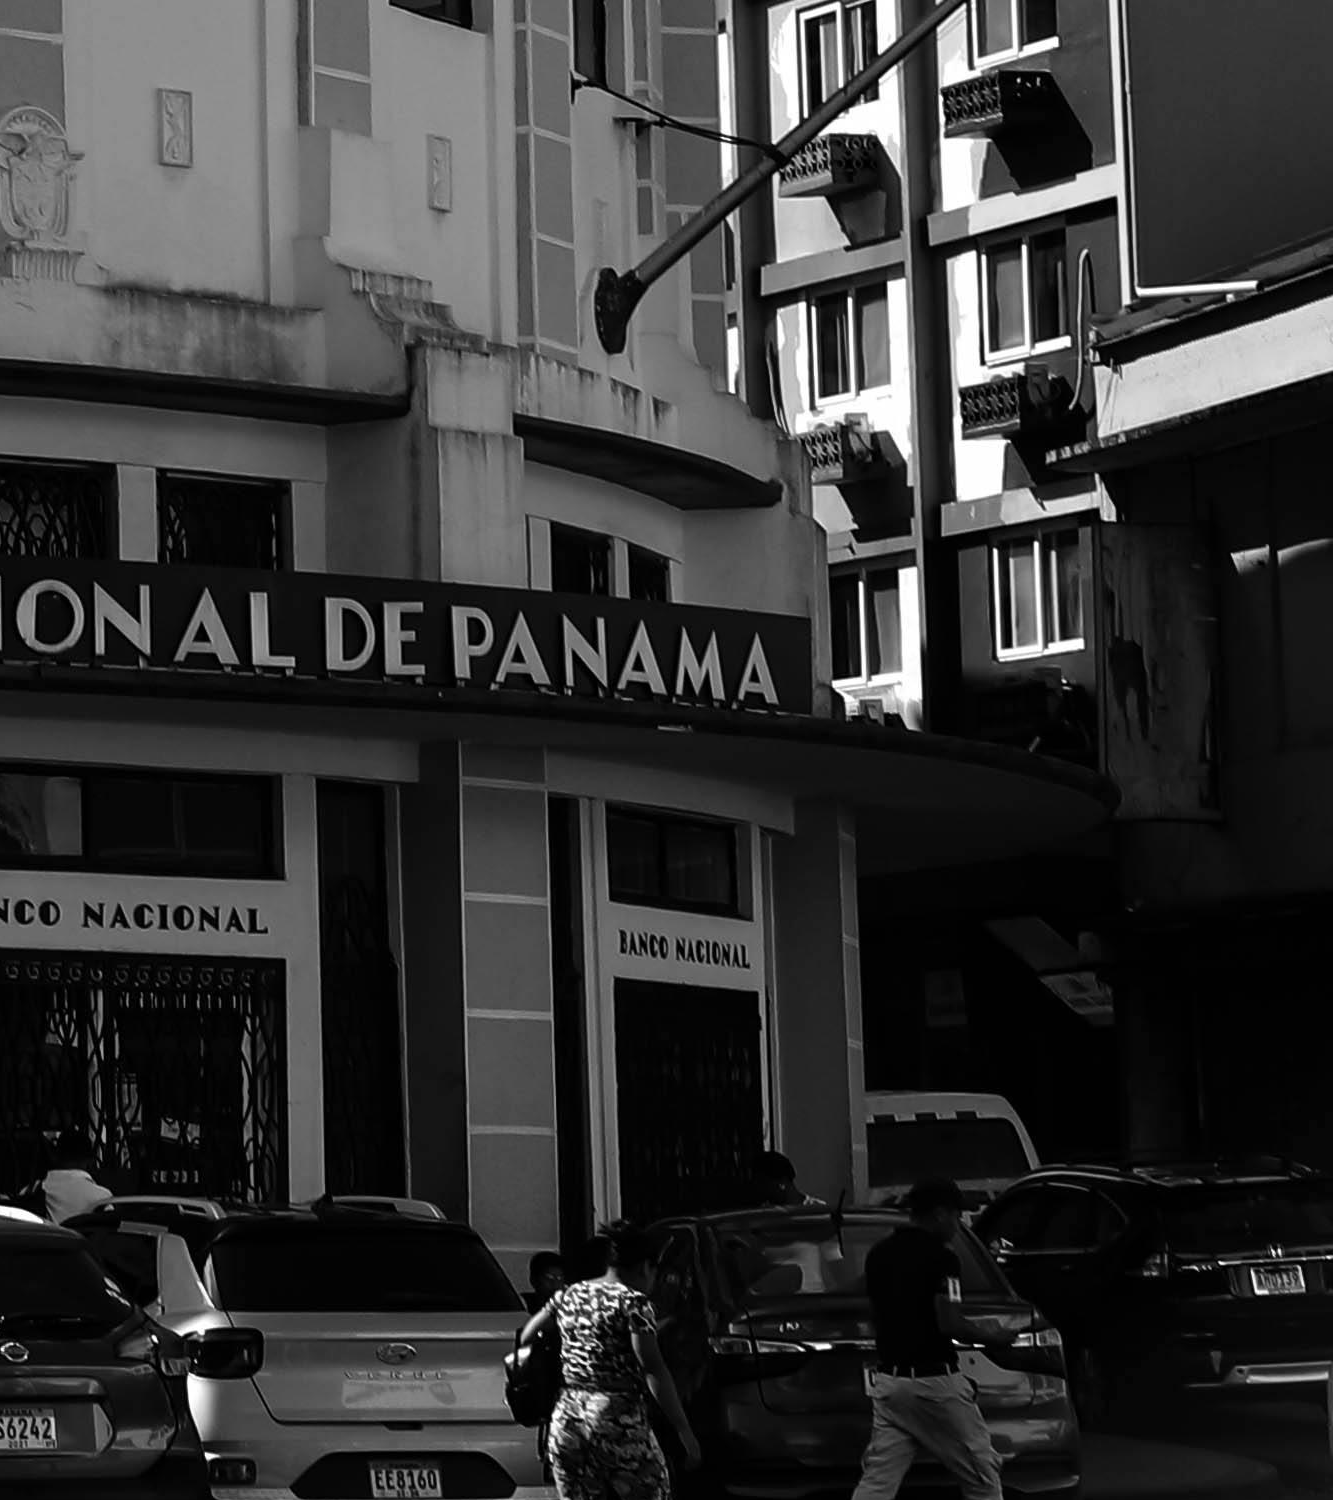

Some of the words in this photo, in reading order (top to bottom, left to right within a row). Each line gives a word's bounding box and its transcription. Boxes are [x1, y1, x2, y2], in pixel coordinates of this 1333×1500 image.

[323, 596, 427, 677] DE
[450, 604, 781, 706] PANAMA
[81, 901, 270, 936] NACIONAL
[618, 929, 670, 961] BANCO
[674, 936, 752, 971] NACIONAL
[374, 1470, 438, 1490] EE8160
